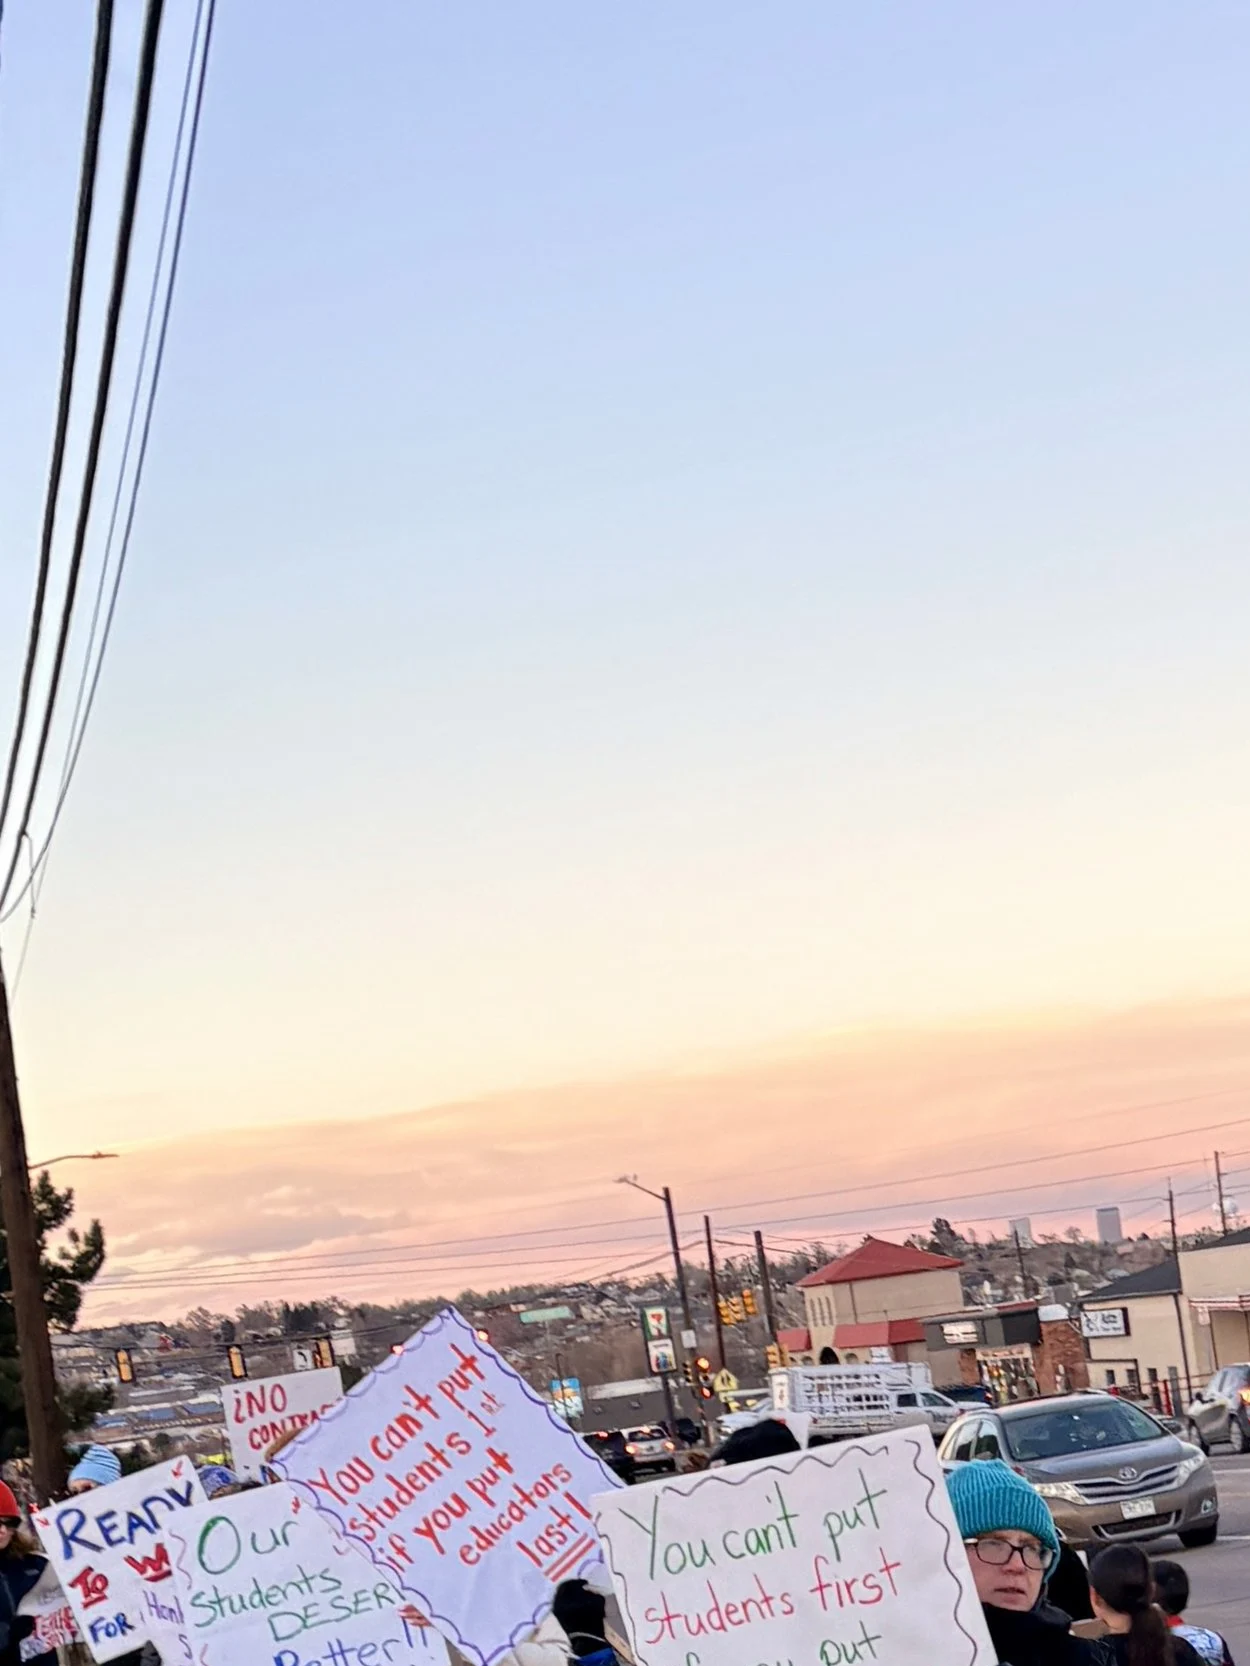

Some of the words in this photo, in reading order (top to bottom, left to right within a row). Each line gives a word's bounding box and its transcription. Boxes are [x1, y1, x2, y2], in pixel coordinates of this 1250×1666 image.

[249, 1397, 342, 1450] CONTRA
[369, 1385, 441, 1462] can't
[437, 1343, 487, 1413] put
[377, 1533, 415, 1574] if
[413, 1492, 472, 1556] you
[466, 1446, 516, 1508] put
[458, 1462, 573, 1566] educators
[618, 1494, 717, 1580] You
[722, 1480, 800, 1561] can't
[822, 1468, 888, 1563] put
[197, 1515, 300, 1576] Our
[809, 1546, 902, 1611] first
[88, 1612, 136, 1645] FOR
[268, 1582, 403, 1643] DESER
